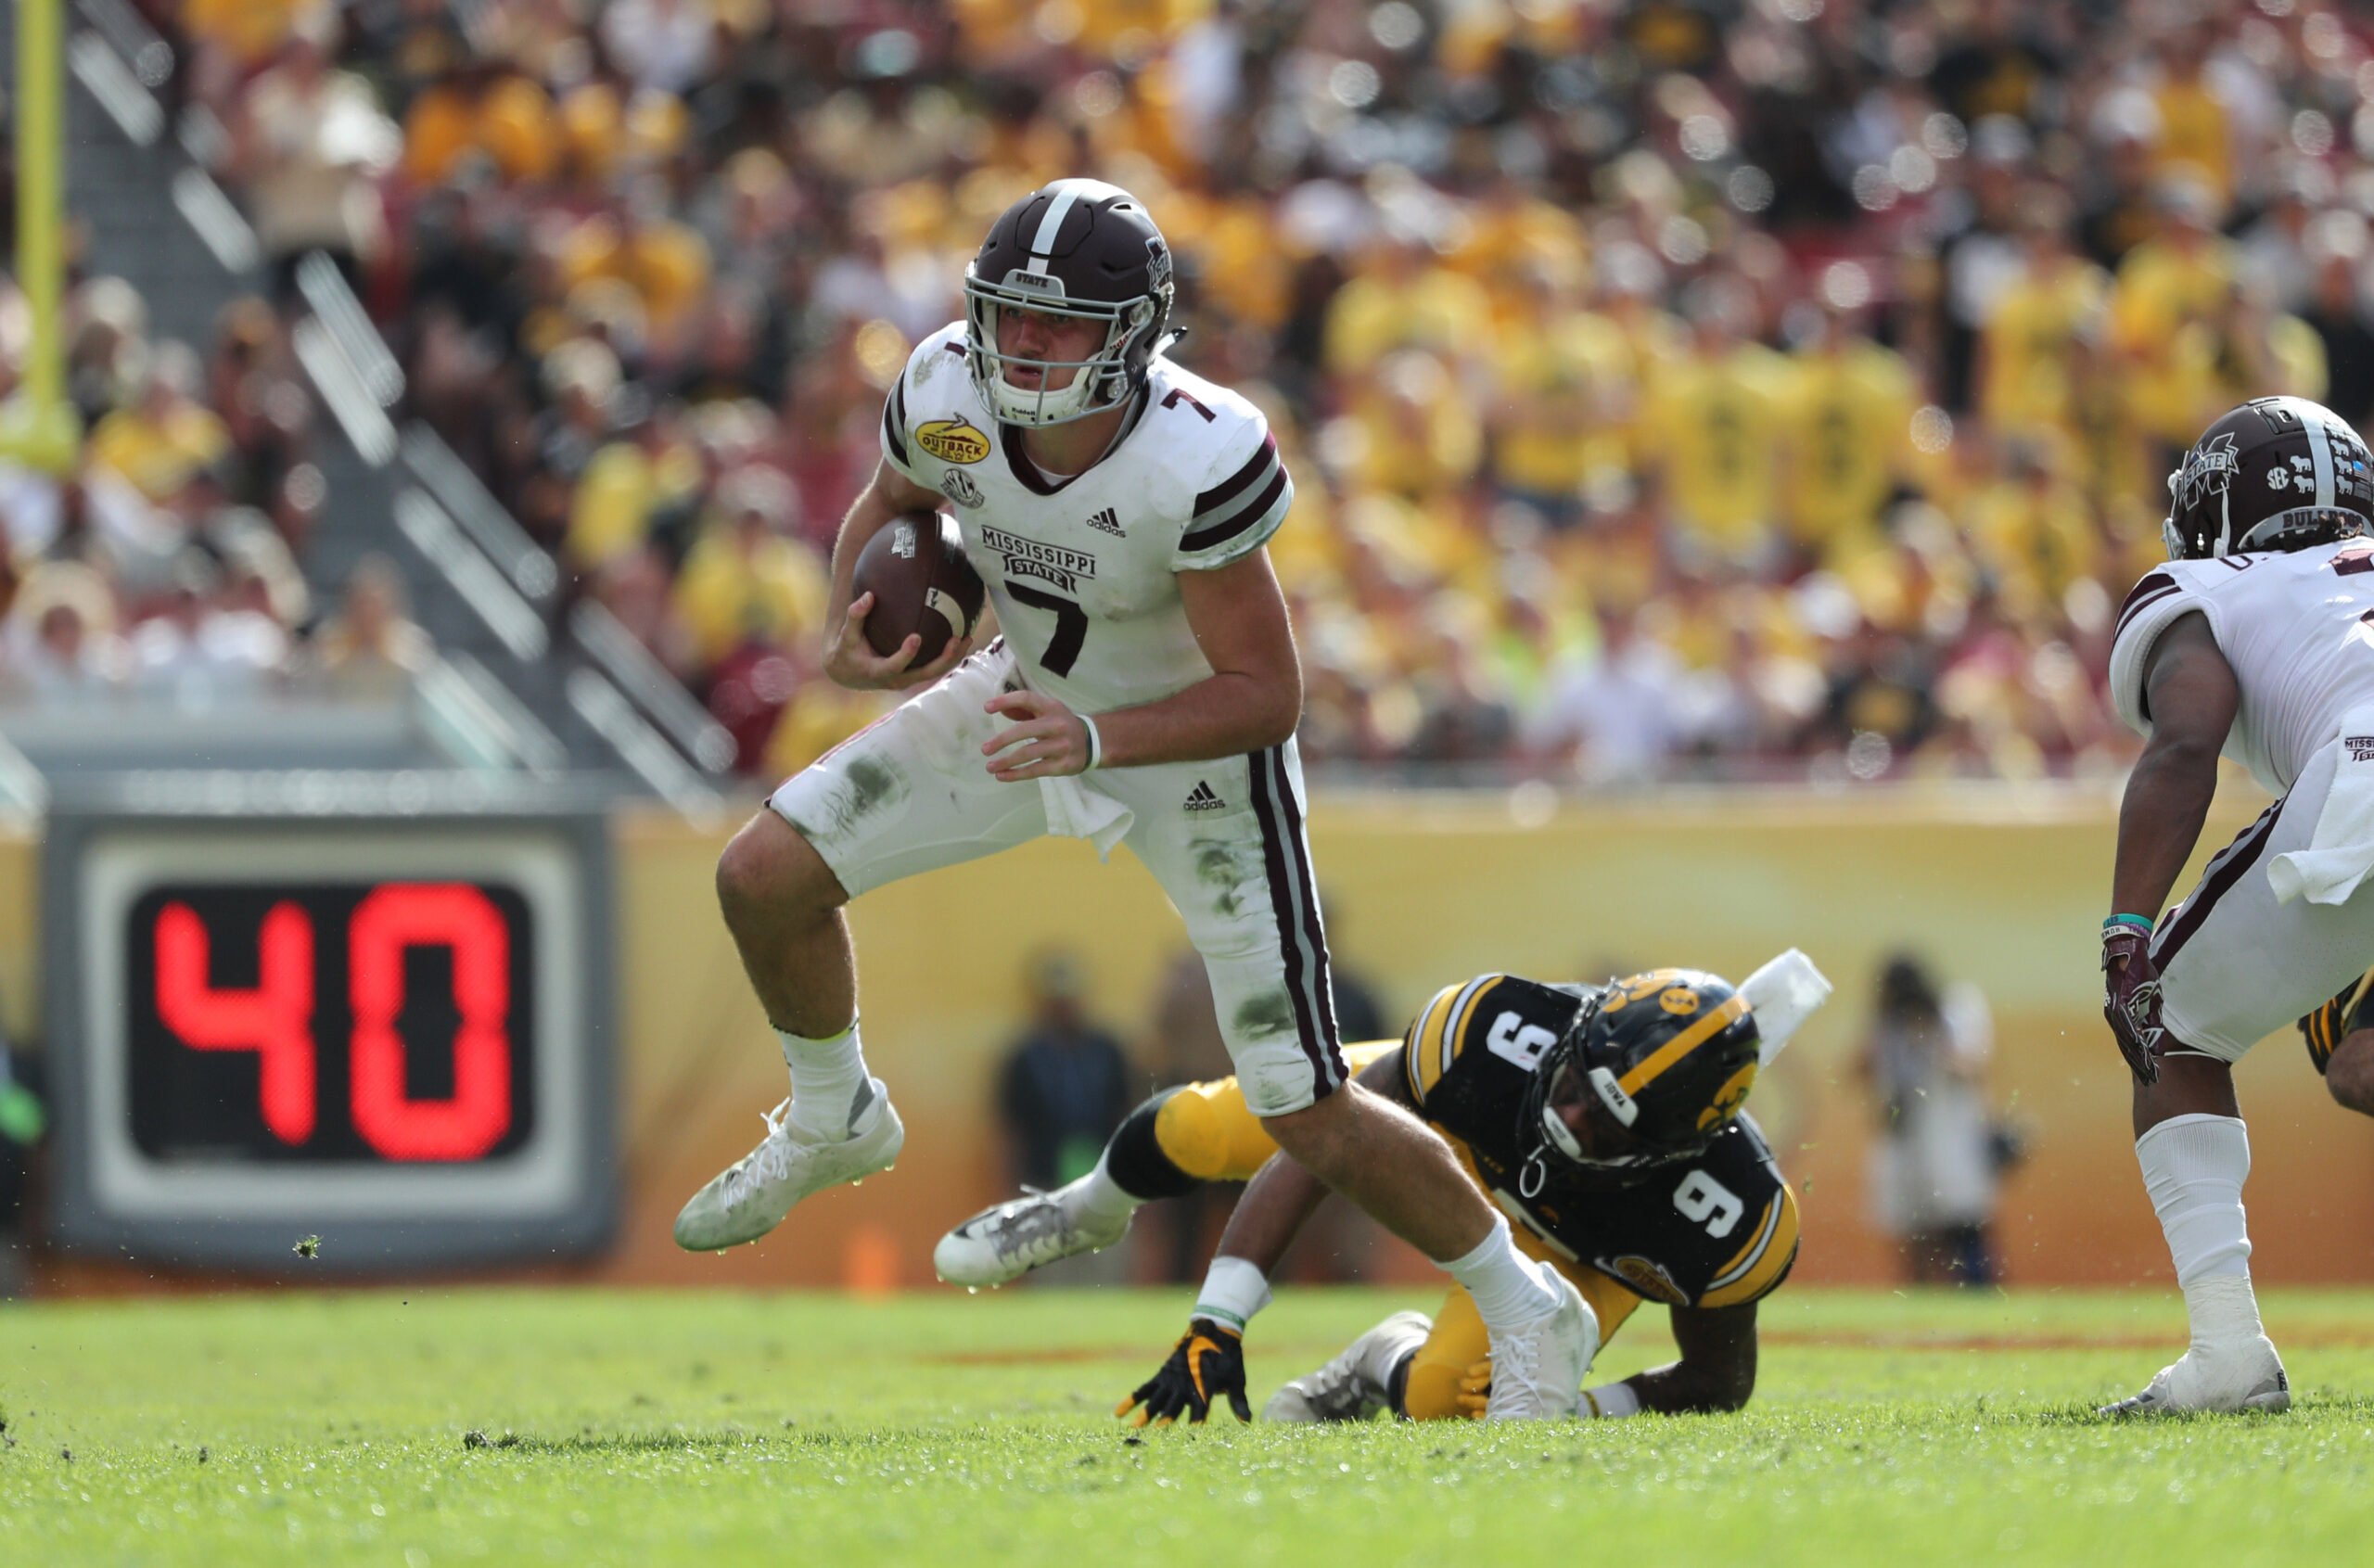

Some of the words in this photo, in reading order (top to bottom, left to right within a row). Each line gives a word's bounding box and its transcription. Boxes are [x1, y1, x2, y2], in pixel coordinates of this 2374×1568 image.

[1015, 273, 1048, 288] STATE
[1160, 388, 1217, 423] 7
[923, 437, 982, 455] OUTBACK
[2184, 453, 2227, 491] STATE
[2266, 466, 2290, 490] SEC
[1087, 518, 1127, 538] adidas
[2282, 509, 2364, 529] BULDOGS
[982, 529, 1096, 576] MISSISSIPPI
[1014, 560, 1066, 587] STATE
[1003, 579, 1089, 679] 7
[1183, 798, 1226, 810] adidas
[153, 881, 512, 1163] 40
[1603, 1081, 1626, 1108] IOWA
[1672, 1168, 1744, 1240] 9
